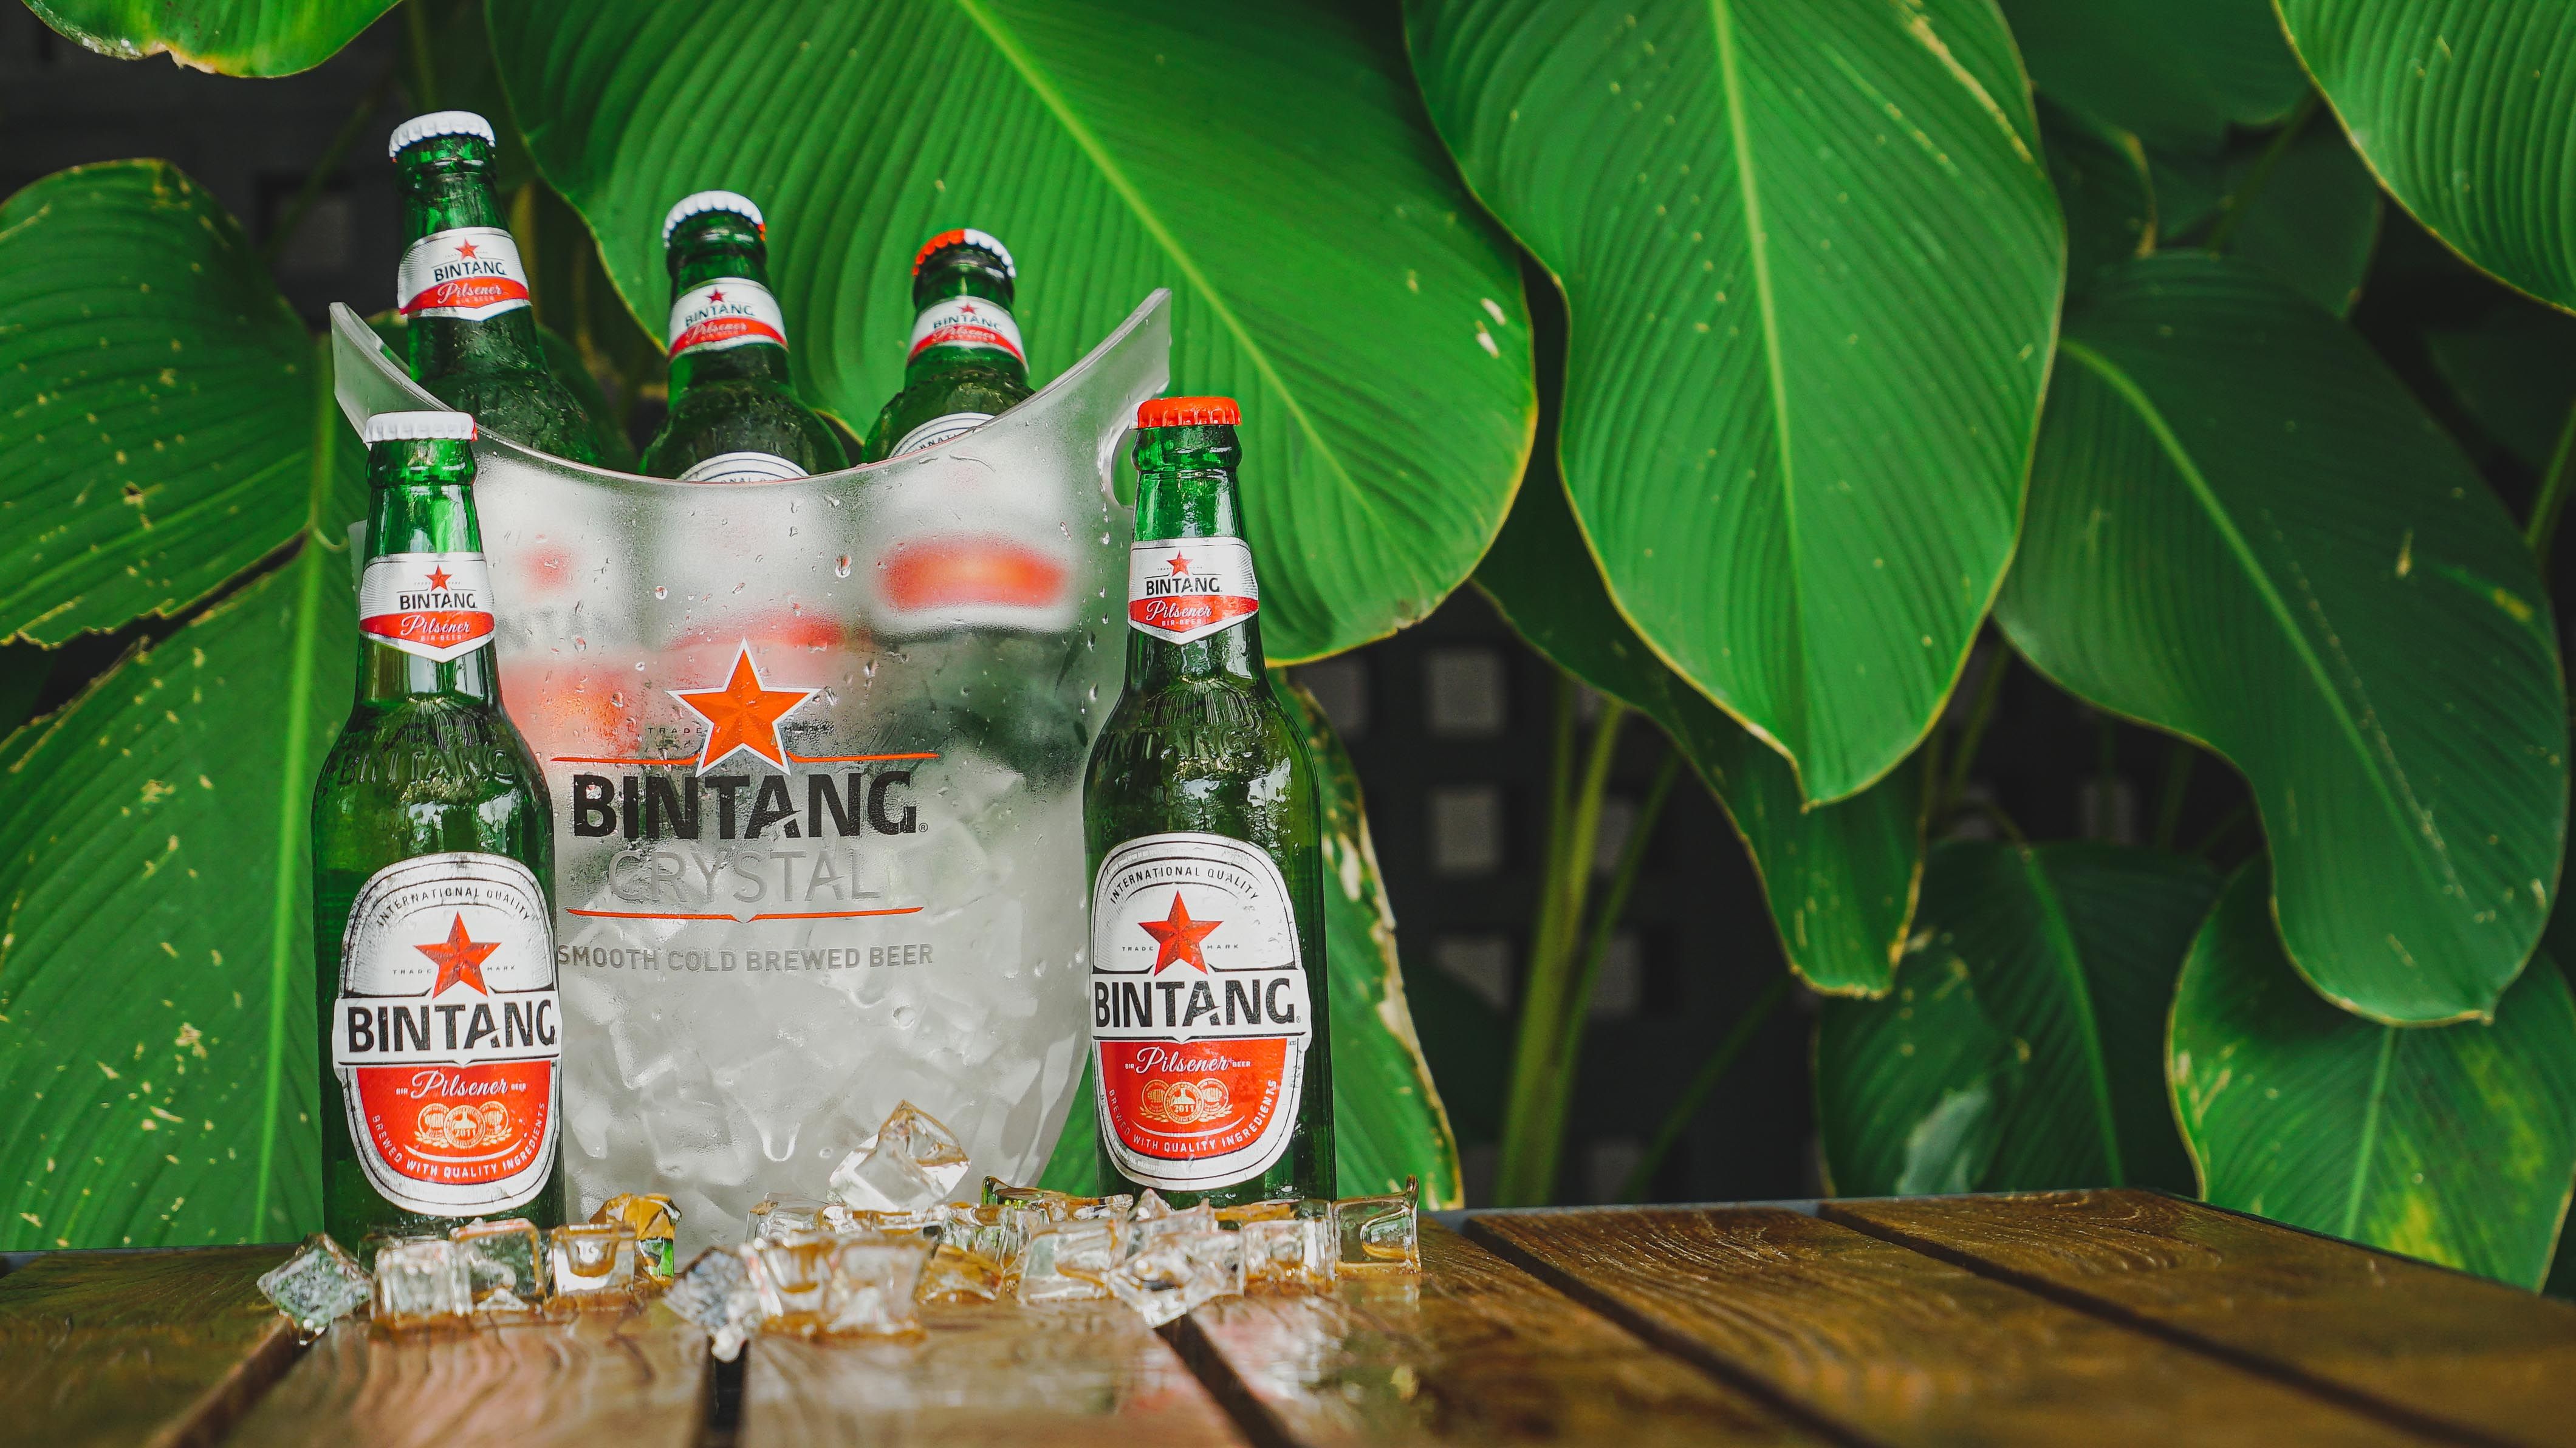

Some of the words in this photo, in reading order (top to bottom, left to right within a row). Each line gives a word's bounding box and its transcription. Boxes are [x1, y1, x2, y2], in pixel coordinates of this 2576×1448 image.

[434, 261, 508, 282] BINTANG
[437, 282, 502, 304] Pilsener
[685, 304, 755, 327] BINTANG
[933, 315, 1003, 333] BINTANG
[1146, 577, 1220, 596] BINTANG
[400, 592, 476, 610] BINTANG
[1146, 599, 1213, 621] Pilsener
[400, 614, 471, 635] Pilsener
[572, 770, 917, 839] BINTANG
[608, 850, 880, 903] CRYSTAL
[1109, 866, 1201, 905] INTERNATIONAL
[1207, 868, 1259, 900] QUALITY
[376, 886, 480, 927] INTERNATIONAL
[486, 890, 530, 921] QUALITY
[558, 944, 659, 970] SMOOTH
[668, 949, 737, 971] COLD
[746, 947, 860, 972] BREWED
[869, 943, 933, 968] BEER
[1094, 977, 1295, 1028] BINTANG
[348, 999, 555, 1053] BINTANG
[1135, 1046, 1229, 1074] Pilsener
[410, 1070, 508, 1099] Pilsener
[1109, 1088, 1131, 1136] BREWED
[1133, 1134, 1159, 1150] WITH
[1164, 1139, 1216, 1153] QUALITY
[1221, 1079, 1277, 1147] INGREDIENTS
[1174, 1104, 1194, 1113] 2011
[372, 1115, 402, 1163] BREWED
[406, 1161, 438, 1176] WITH
[444, 1163, 498, 1179] QUALITY
[502, 1102, 546, 1172] INGREDIENTS
[456, 1128, 476, 1137] 2011
